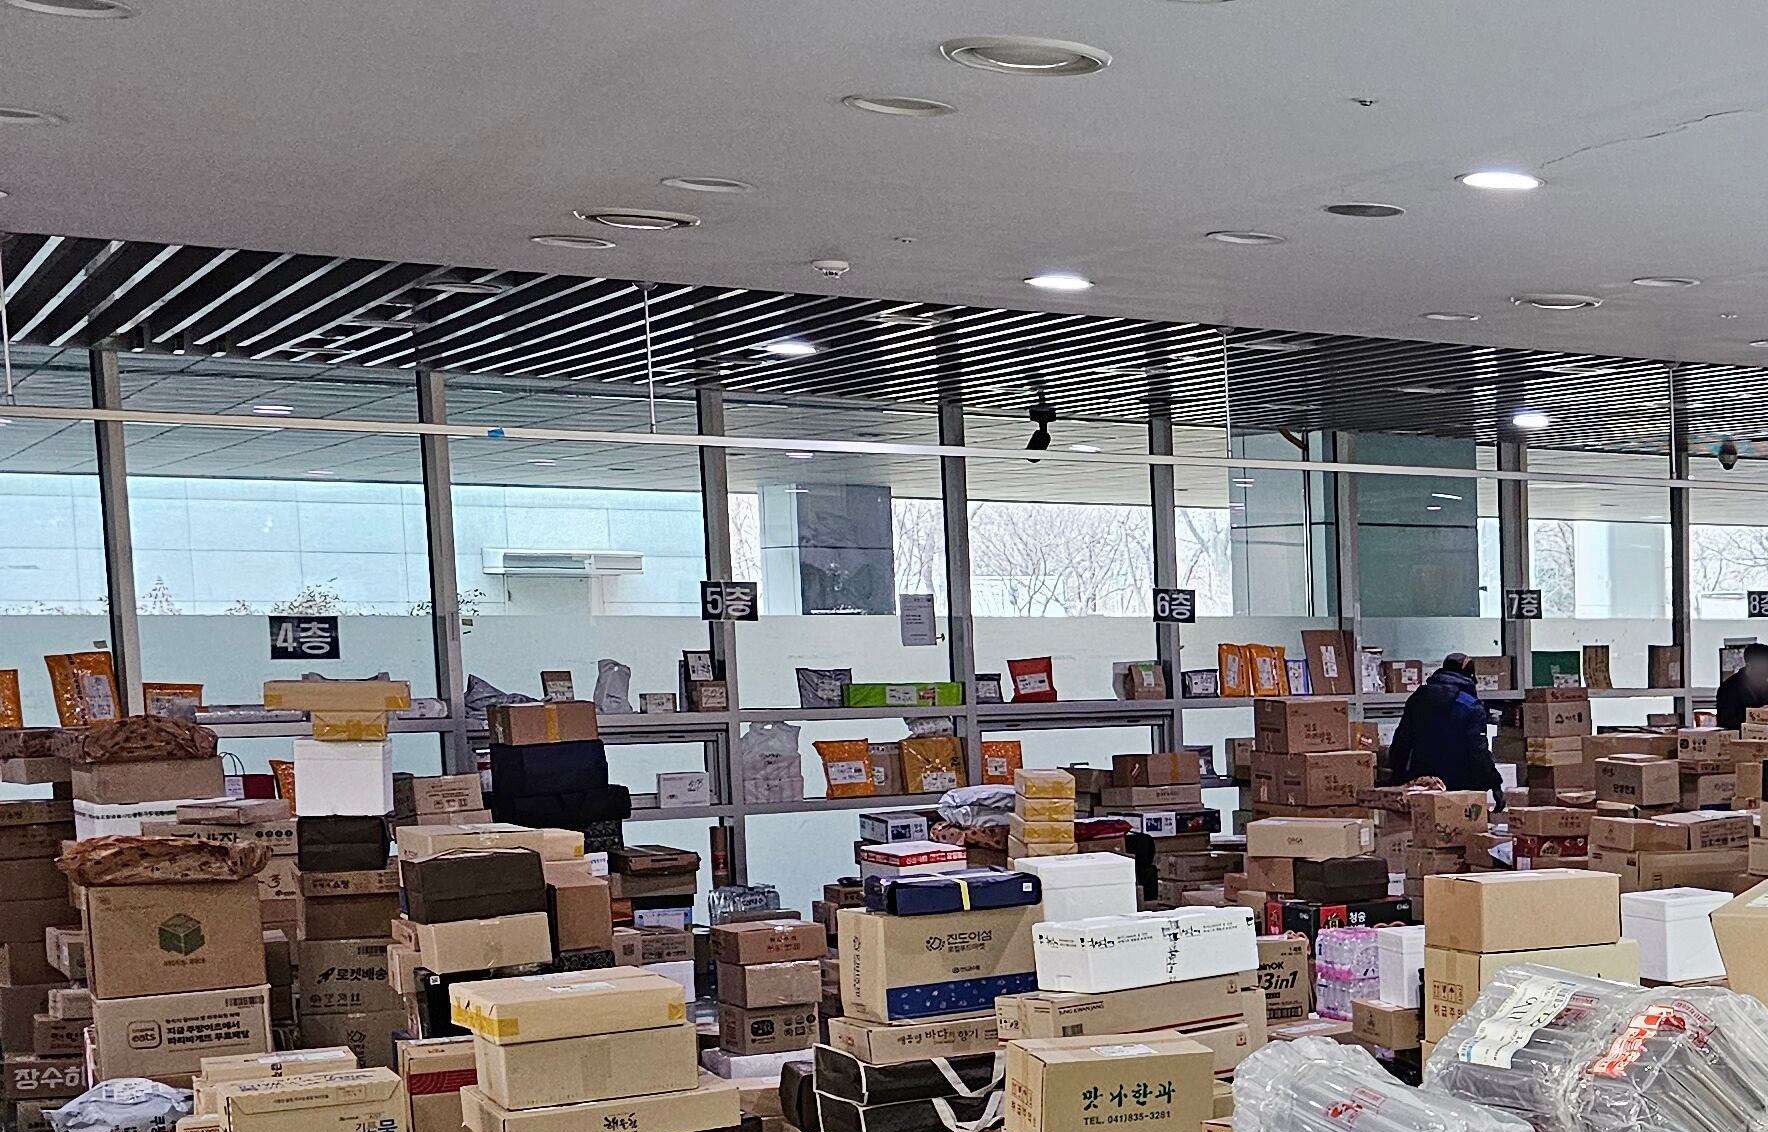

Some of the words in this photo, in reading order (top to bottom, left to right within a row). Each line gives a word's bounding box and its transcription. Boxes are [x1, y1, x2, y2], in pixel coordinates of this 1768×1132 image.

[705, 586, 753, 617] 5층
[1155, 591, 1193, 621] 6층
[1507, 591, 1539, 617] 7층
[275, 620, 332, 656] 4층
[1349, 911, 1367, 924] 청송
[335, 967, 389, 982] 로켓배송
[165, 1023, 185, 1035] 지금
[185, 1019, 241, 1035] 쿠팡이츠에서
[214, 1029, 250, 1043] 무료배달
[131, 1032, 157, 1044] eats
[1081, 1079, 1177, 1112] 맛나한과
[1083, 1116, 1105, 1127] TEL.
[1107, 1109, 1171, 1125] 041)835-3281
